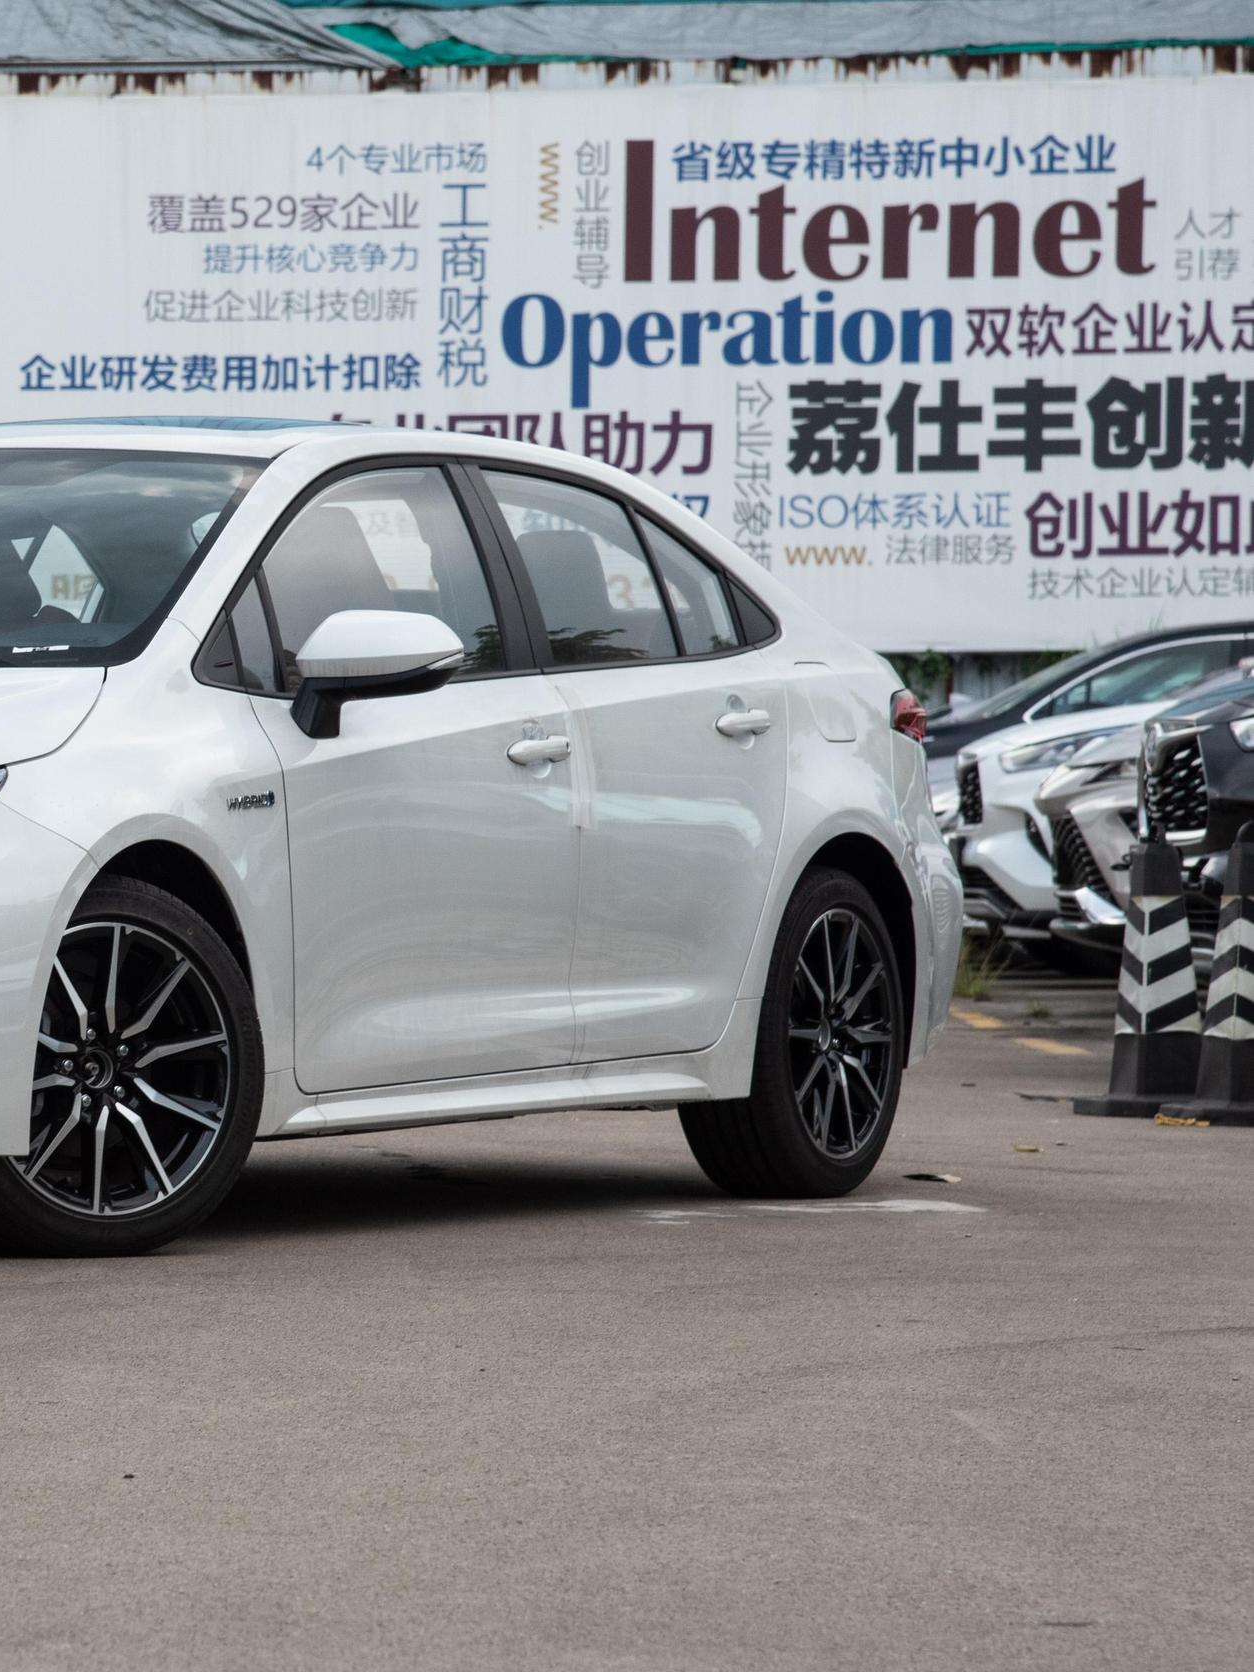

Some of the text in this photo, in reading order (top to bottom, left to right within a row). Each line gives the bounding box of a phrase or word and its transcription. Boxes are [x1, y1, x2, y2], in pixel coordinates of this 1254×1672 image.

[306, 142, 487, 174] 4个专业市场
[672, 134, 1116, 182] 省级专精特新中小企业
[148, 192, 421, 233] 覆盖529家企业
[573, 140, 611, 289] 创业辅导
[624, 140, 1157, 282] Internet
[1174, 207, 1241, 240] 人才
[203, 242, 419, 274] 提升核心竞争力
[143, 287, 419, 323] 促进企业科技创新
[437, 183, 489, 388] 工商财税
[501, 290, 952, 409] Operation
[19, 352, 422, 392] 企业研发费用加计扣除
[787, 373, 1254, 475] 荔仕丰创新
[778, 491, 1011, 530] ISO体系认证
[1024, 489, 1254, 559] 创业如
[885, 533, 1016, 566] 法律服务
